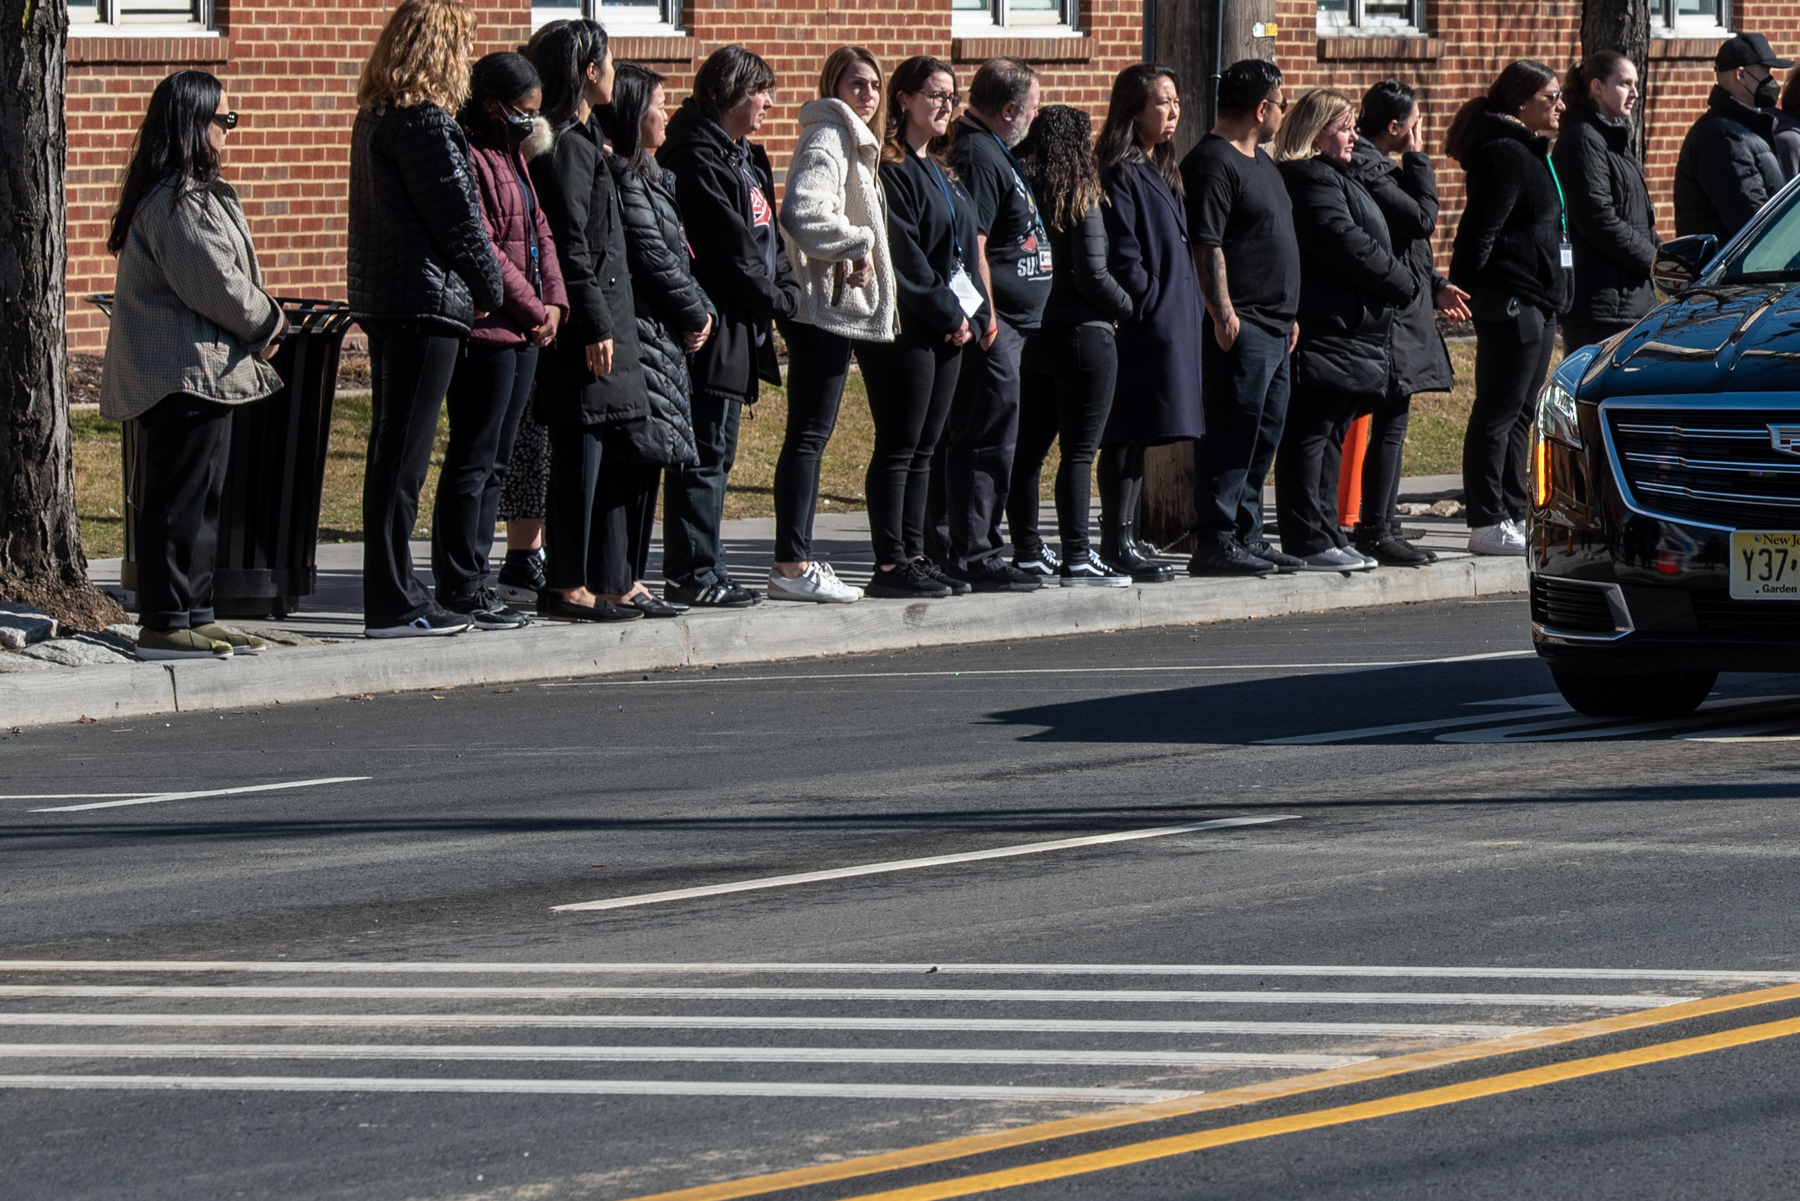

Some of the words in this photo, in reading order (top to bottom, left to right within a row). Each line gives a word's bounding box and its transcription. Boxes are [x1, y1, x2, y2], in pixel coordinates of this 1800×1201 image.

[1763, 534, 1790, 546] New
[1742, 548, 1789, 582] Y37
[1762, 583, 1798, 594] Garden
